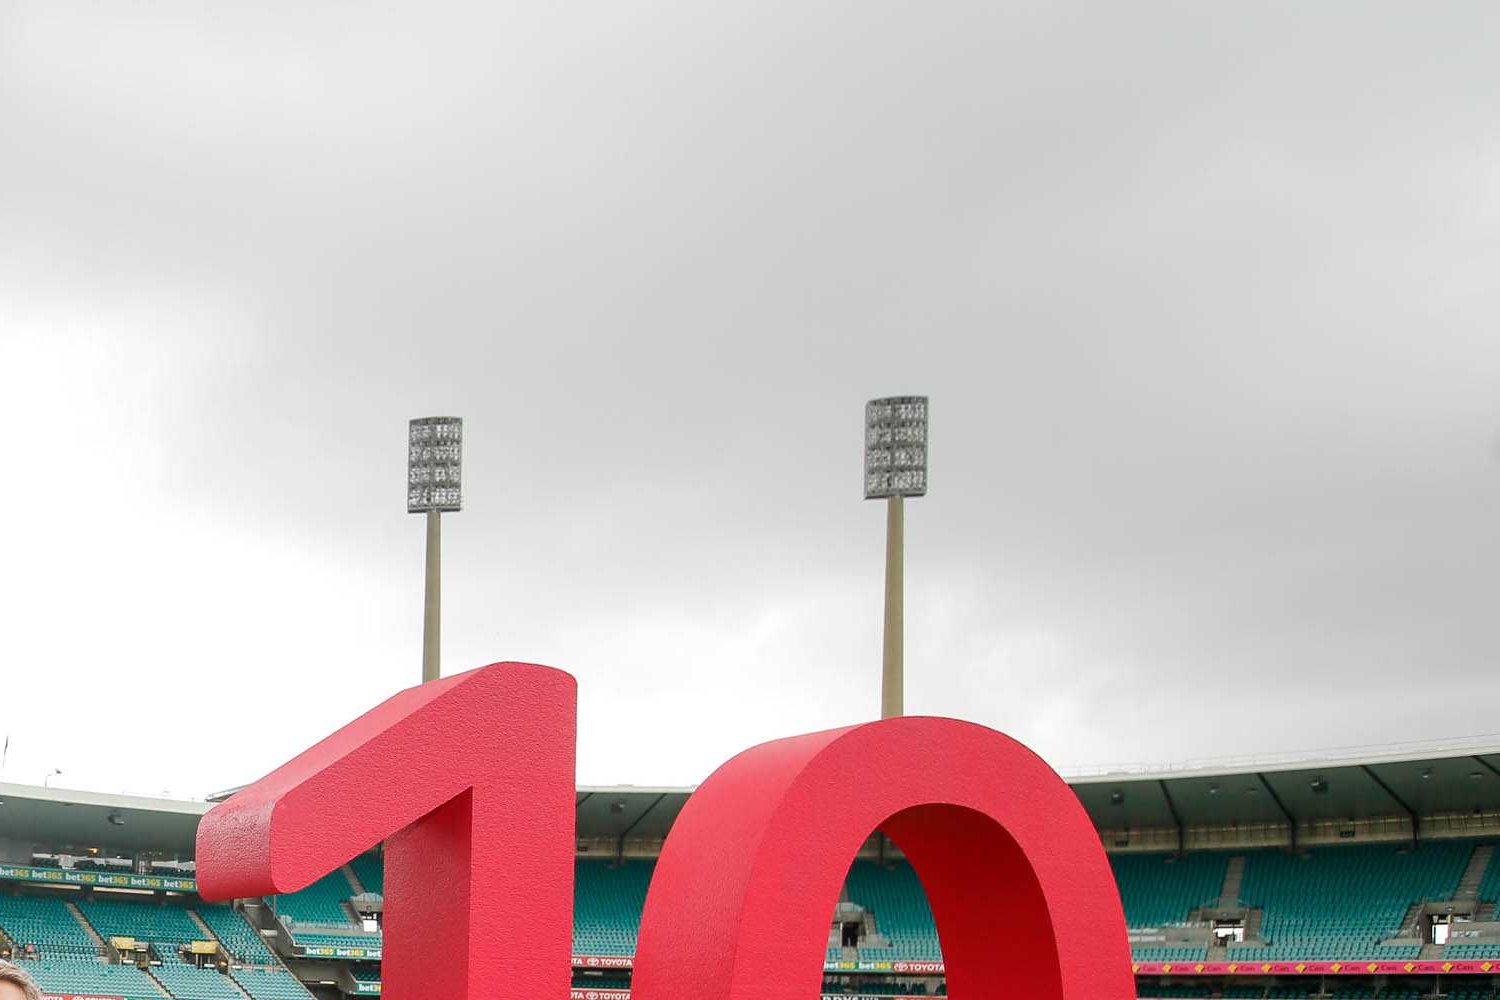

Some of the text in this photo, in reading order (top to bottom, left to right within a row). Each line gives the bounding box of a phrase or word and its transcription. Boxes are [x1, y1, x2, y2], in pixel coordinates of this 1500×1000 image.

[0, 868, 29, 878] bet365
[32, 870, 63, 880] bet365
[65, 872, 96, 882] bet365
[98, 875, 129, 885] bet365
[131, 877, 161, 887] bet365
[164, 879, 194, 889] bet365
[909, 963, 945, 972] TOYOTA
[599, 992, 631, 1000] TOYOTA
